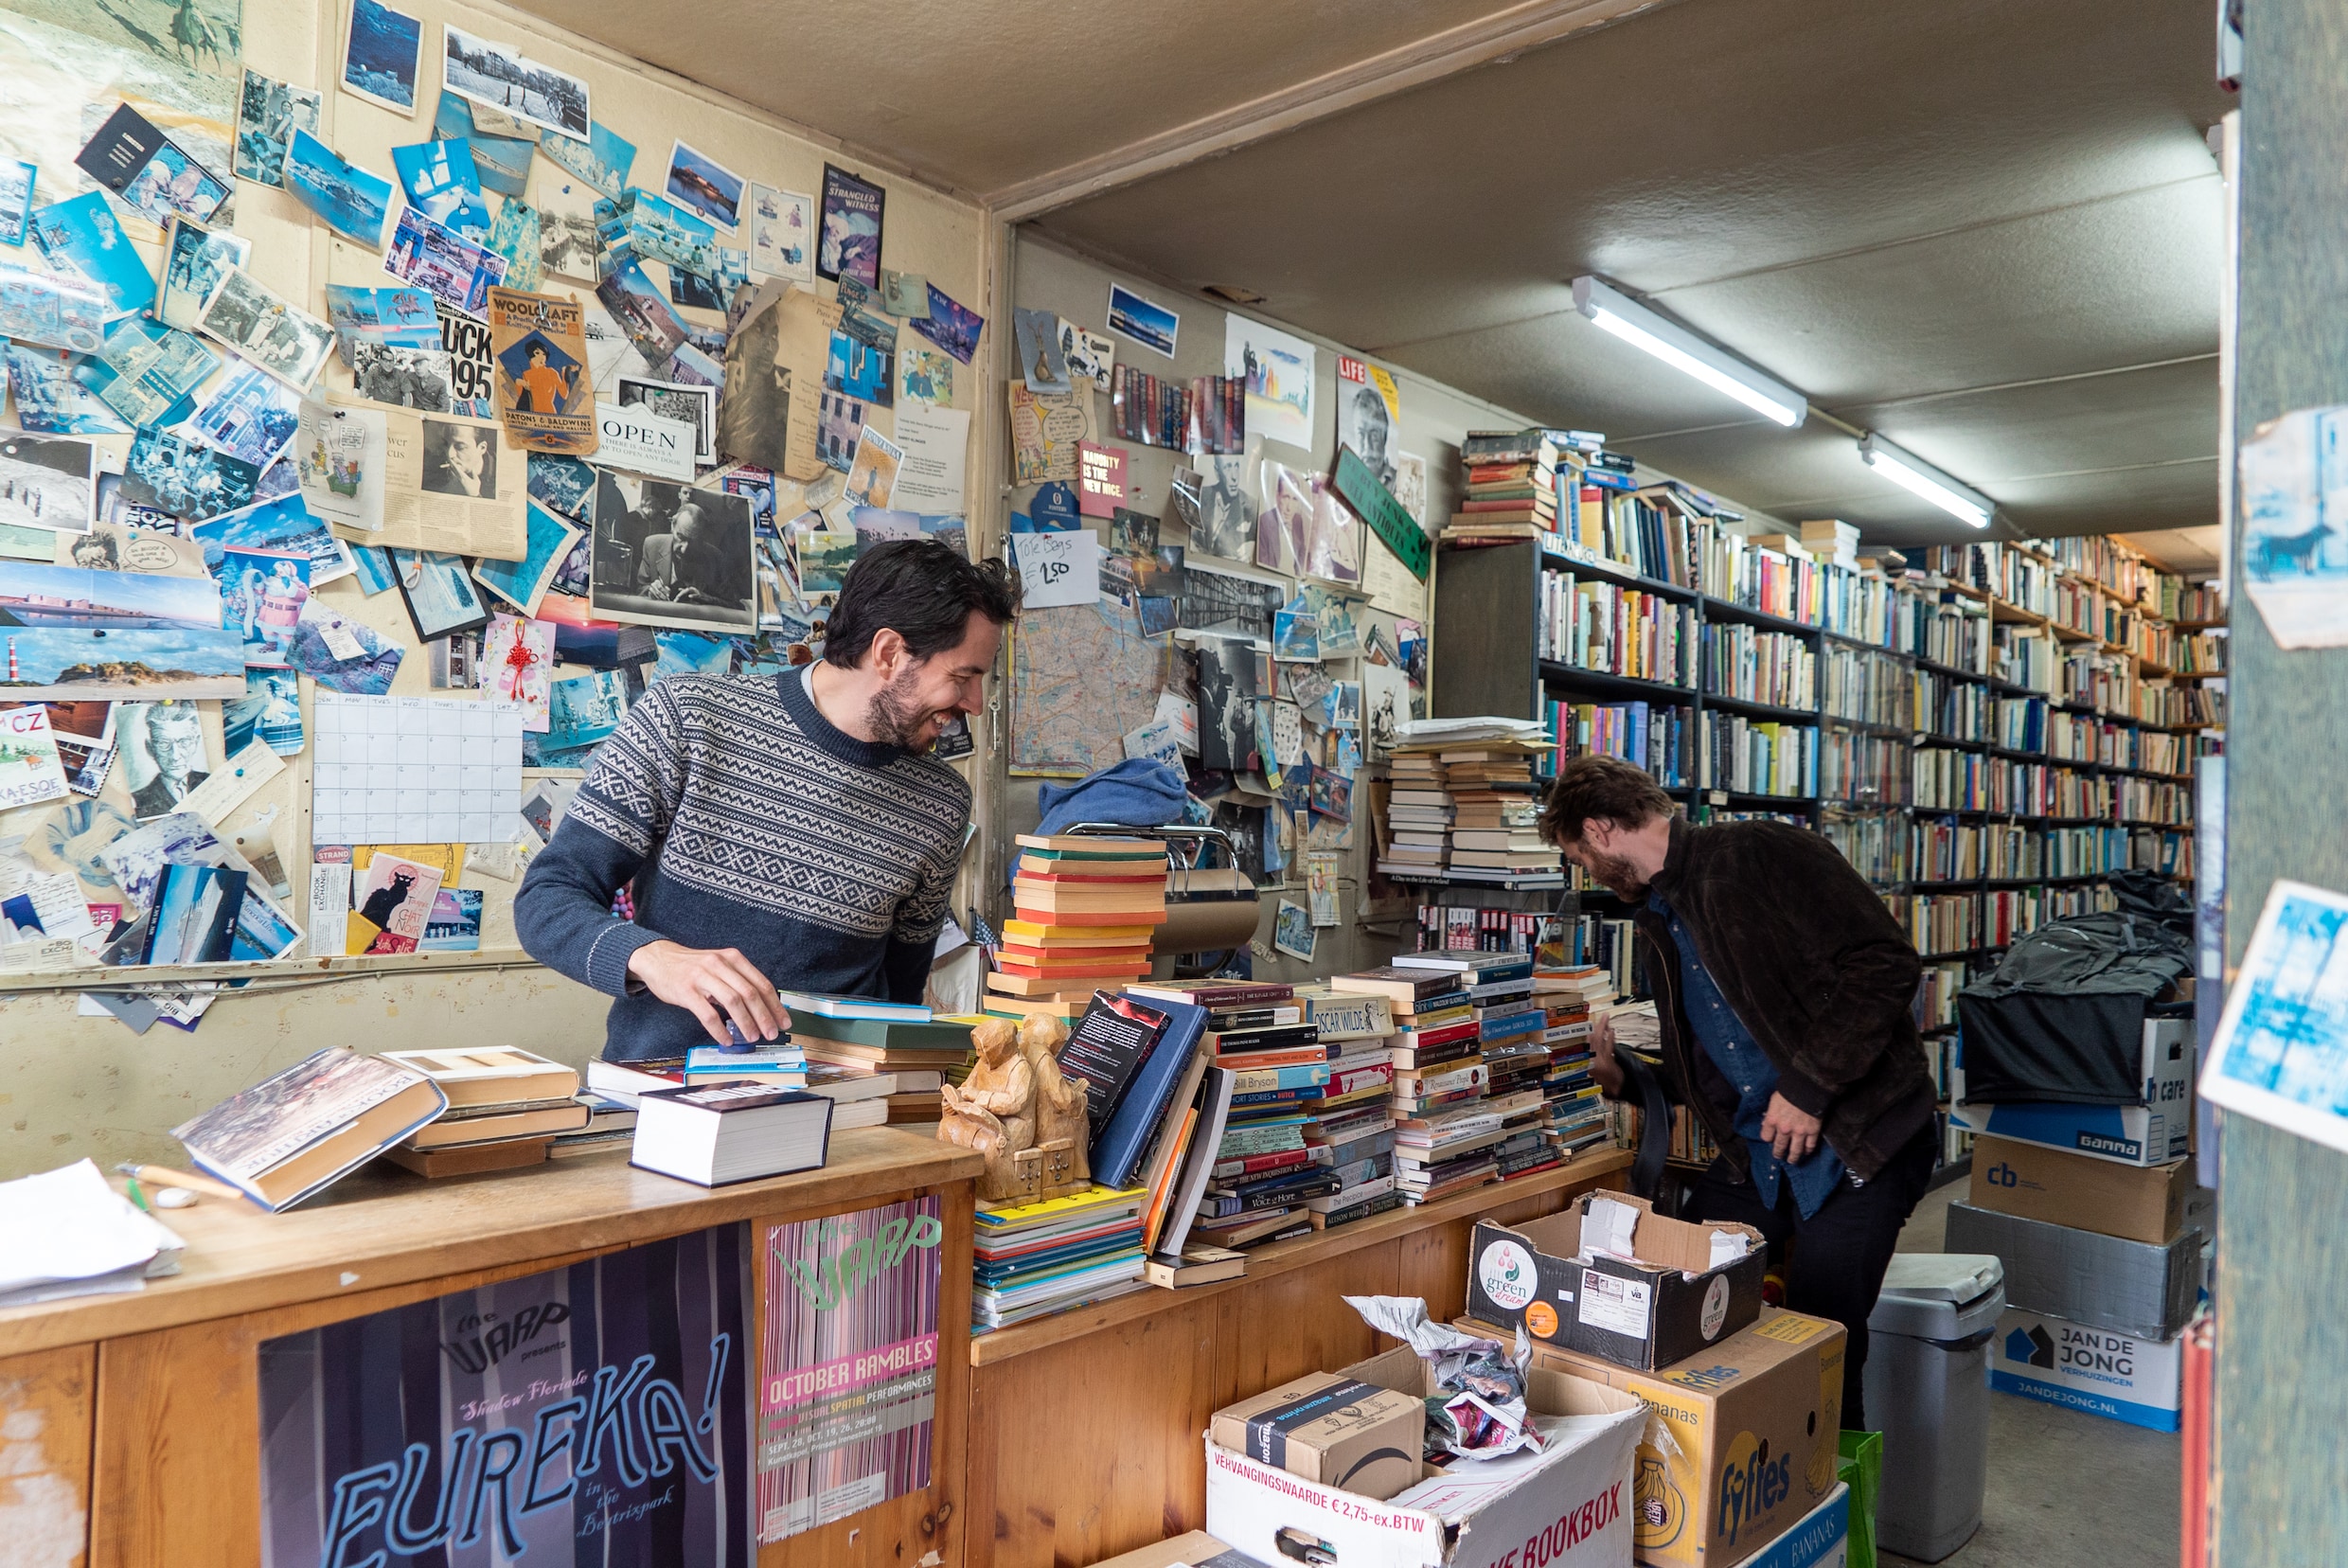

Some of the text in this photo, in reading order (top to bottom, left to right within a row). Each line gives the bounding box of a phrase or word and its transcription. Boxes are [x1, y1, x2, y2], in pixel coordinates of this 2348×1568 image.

[828, 187, 876, 203] STRANGLED
[845, 199, 880, 213] WITNESS
[493, 298, 578, 322] WOOLCAFT
[507, 320, 532, 331] Knitting
[436, 315, 494, 365] UCK
[1338, 355, 1366, 383] LIFE
[506, 412, 536, 423] PATONS
[547, 417, 591, 427] BALDWINS
[603, 419, 676, 450] OPEN
[864, 427, 883, 447] FRANZ
[606, 437, 629, 449] THERE
[639, 445, 666, 455] ALWAYS
[623, 448, 643, 457] OPEN
[661, 457, 681, 466] DOOR
[709, 458, 744, 480] MADRID
[1082, 450, 1120, 471] NAUGHTY
[1082, 464, 1109, 481] IS THE
[1083, 478, 1124, 498] NEW NICE.
[1343, 473, 1406, 551] SELL ANTIQUES
[1360, 472, 1413, 538] BUY JUNK &
[1043, 539, 1073, 559] Bags
[1025, 561, 1039, 590] €
[11, 712, 44, 733] CZ
[318, 851, 349, 861] STRAND
[318, 867, 328, 911] EXCHANGE
[399, 909, 423, 923] CHAT
[396, 918, 420, 937] NOIR
[163, 1002, 180, 1016] BIG
[1432, 995, 1466, 1008] MALCOLM GLADWELL
[1315, 1010, 1364, 1034] OSCAR WILDE
[1234, 1078, 1276, 1089] Bill Bryson
[1454, 1074, 1469, 1087] People
[2161, 1078, 2185, 1101] care
[1161, 1087, 1175, 1109] POOH
[1248, 1091, 1295, 1102] STORIES DUTCH
[1147, 1108, 1165, 1138] CORNER
[1330, 1124, 1340, 1132] BRIEF
[1341, 1121, 1355, 1130] HISTORY
[2080, 1135, 2137, 1156] GAMMA
[1239, 1165, 1293, 1184] THE NEW INQUISITION
[1987, 1162, 2018, 1187] cb
[1252, 1193, 1295, 1207] VOICE HOPE
[1333, 1192, 1363, 1206] The Precipice
[1327, 1208, 1363, 1225] ALISON WEIR
[771, 1214, 942, 1311] WARP
[1485, 1275, 1527, 1300] green
[1495, 1289, 1524, 1307] dream
[1704, 1309, 1723, 1332] green
[439, 1302, 571, 1374] WARP
[2059, 1327, 2134, 1356] JAN DE
[521, 1341, 566, 1363] presents
[2059, 1345, 2134, 1377] JONG
[770, 1339, 934, 1405] OCTOBER RAMBLES
[2059, 1364, 2134, 1388] VERHUIZINGEN
[459, 1369, 589, 1421] Shadow Floriade
[2018, 1382, 2118, 1416] JANDEJONG.NL
[317, 1331, 729, 1568] EUREKA!
[768, 1424, 882, 1467] Kunstkapel, Prinses Irenestraat 19
[769, 1442, 790, 1455] SEPT.
[792, 1437, 805, 1449] 28,
[807, 1432, 824, 1445] OCT.
[826, 1427, 839, 1438] 19,
[1263, 1420, 1275, 1464] amazon
[584, 1482, 601, 1497] in
[596, 1488, 620, 1510] the
[1214, 1452, 1328, 1509] VERVANGINGSWAARDE
[1331, 1498, 1341, 1513] €
[1343, 1501, 1425, 1533] 2,75-ex.BTW
[577, 1484, 675, 1539] Beatrixpark
[1521, 1480, 1625, 1568] BOOKBOX
[1791, 1515, 1835, 1561] BANANAS
